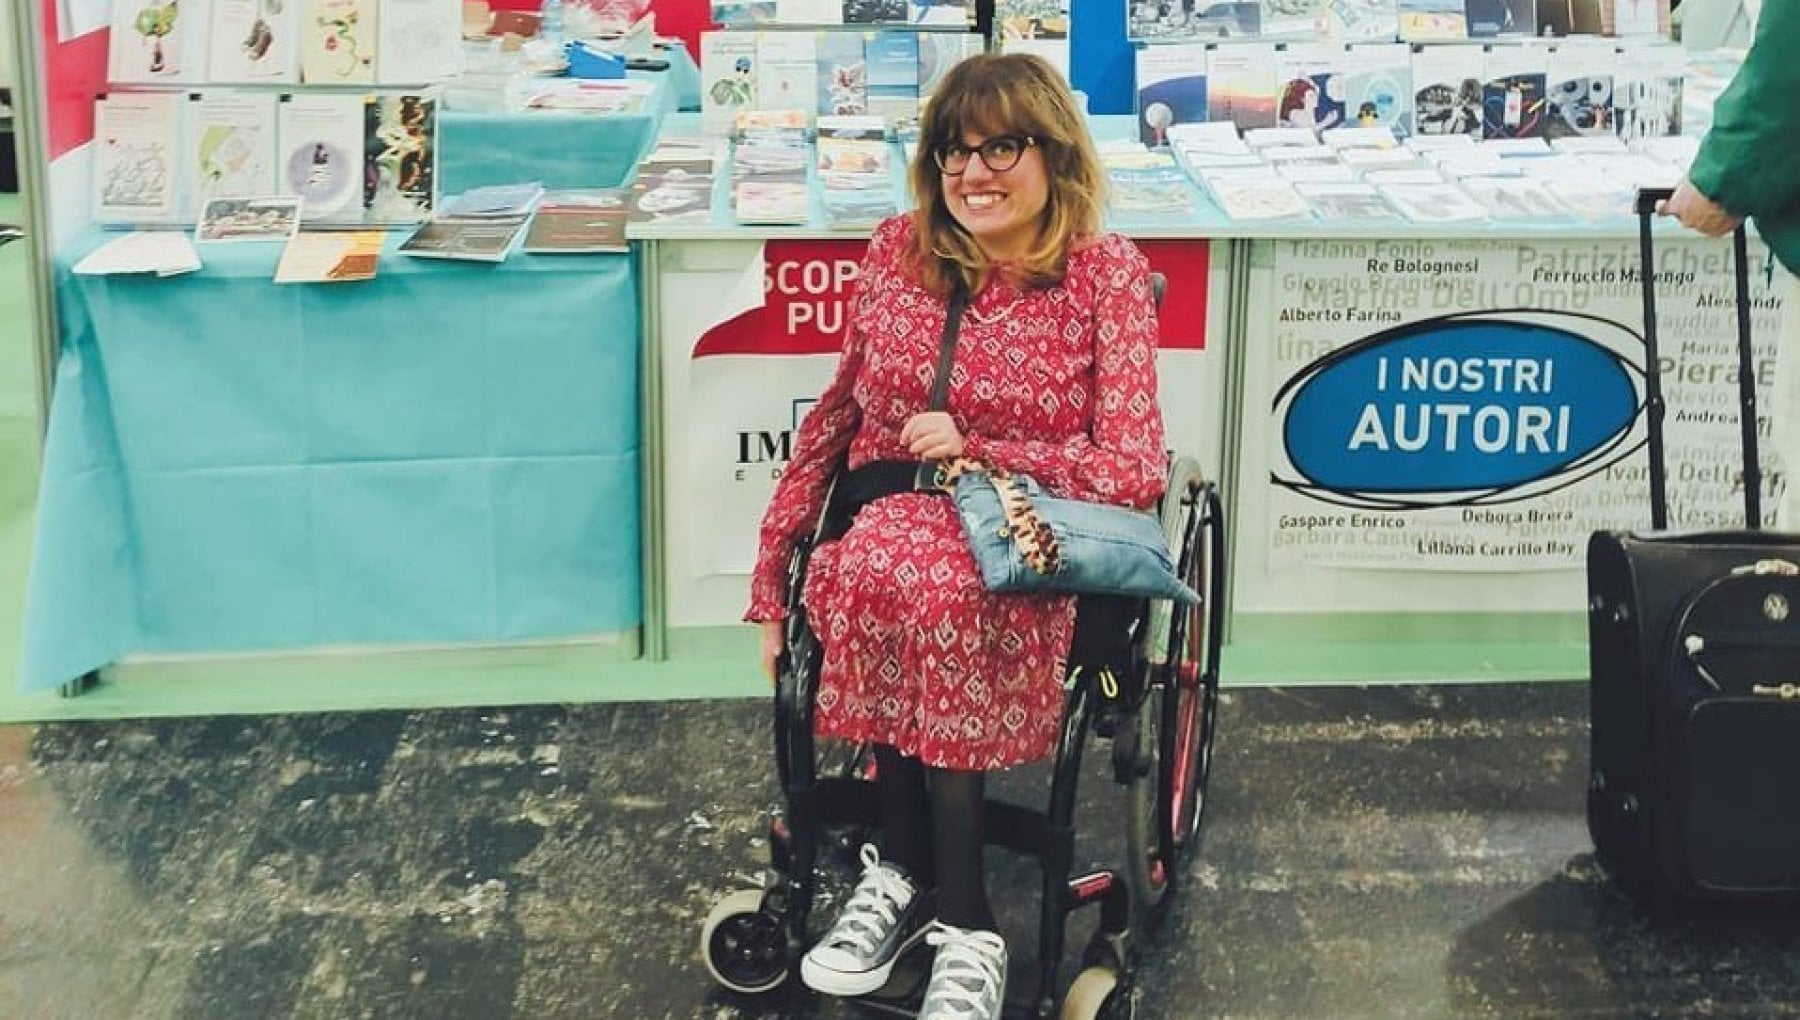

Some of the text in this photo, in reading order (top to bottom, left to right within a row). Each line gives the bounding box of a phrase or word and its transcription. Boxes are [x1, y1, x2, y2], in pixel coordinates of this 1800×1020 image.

[1291, 240, 1367, 258] Tiziana
[1367, 258, 1479, 276] Re Bolognesi
[1517, 245, 1640, 275] Patrizia
[1533, 267, 1695, 286] Ferruccio Maengo
[1279, 306, 1401, 322] Alberto Farina
[1377, 356, 1553, 394] I NOSTRI
[1656, 356, 1741, 385] Piera
[1347, 402, 1571, 454] AUTORI
[1279, 512, 1406, 531] Gaspare Enrico
[1462, 508, 1524, 524] Debora
[1417, 538, 1476, 556] Liliana
[1480, 541, 1542, 557] Carrillo
